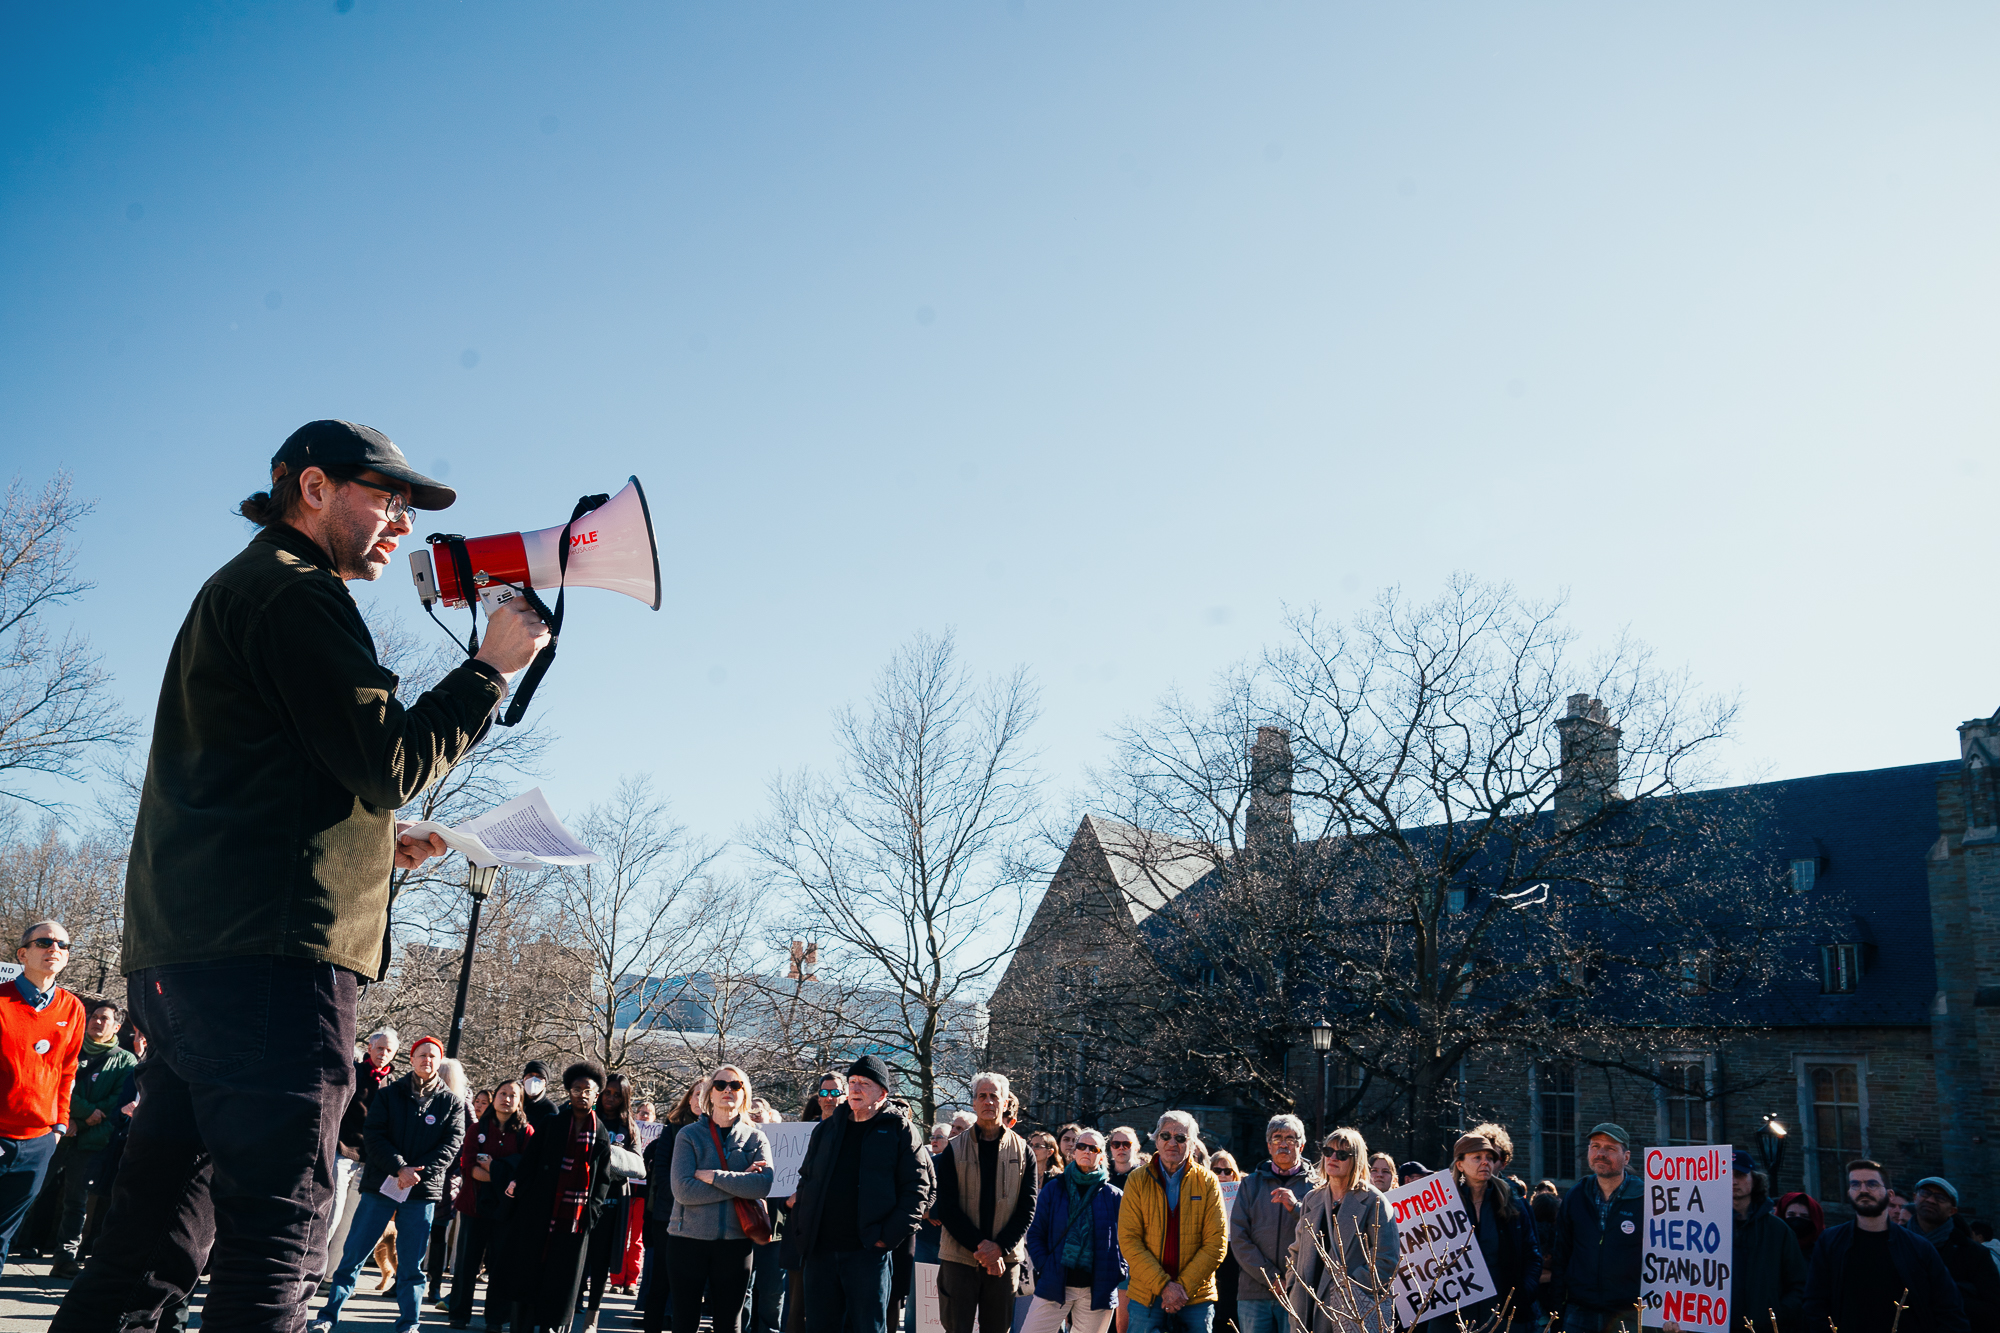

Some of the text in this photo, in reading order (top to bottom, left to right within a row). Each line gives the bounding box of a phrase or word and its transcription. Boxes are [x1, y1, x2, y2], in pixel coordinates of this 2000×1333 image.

[0, 966, 15, 974] ND
[765, 1131, 811, 1158] HAN
[1646, 1150, 1728, 1182] Cornell:
[1392, 1179, 1453, 1223] ornell:
[1651, 1185, 1705, 1216] BE A
[1399, 1223, 1442, 1255] TAND
[1650, 1218, 1721, 1254] HERO
[1406, 1272, 1484, 1315] BACK
[1642, 1290, 1728, 1326] TO NERO
